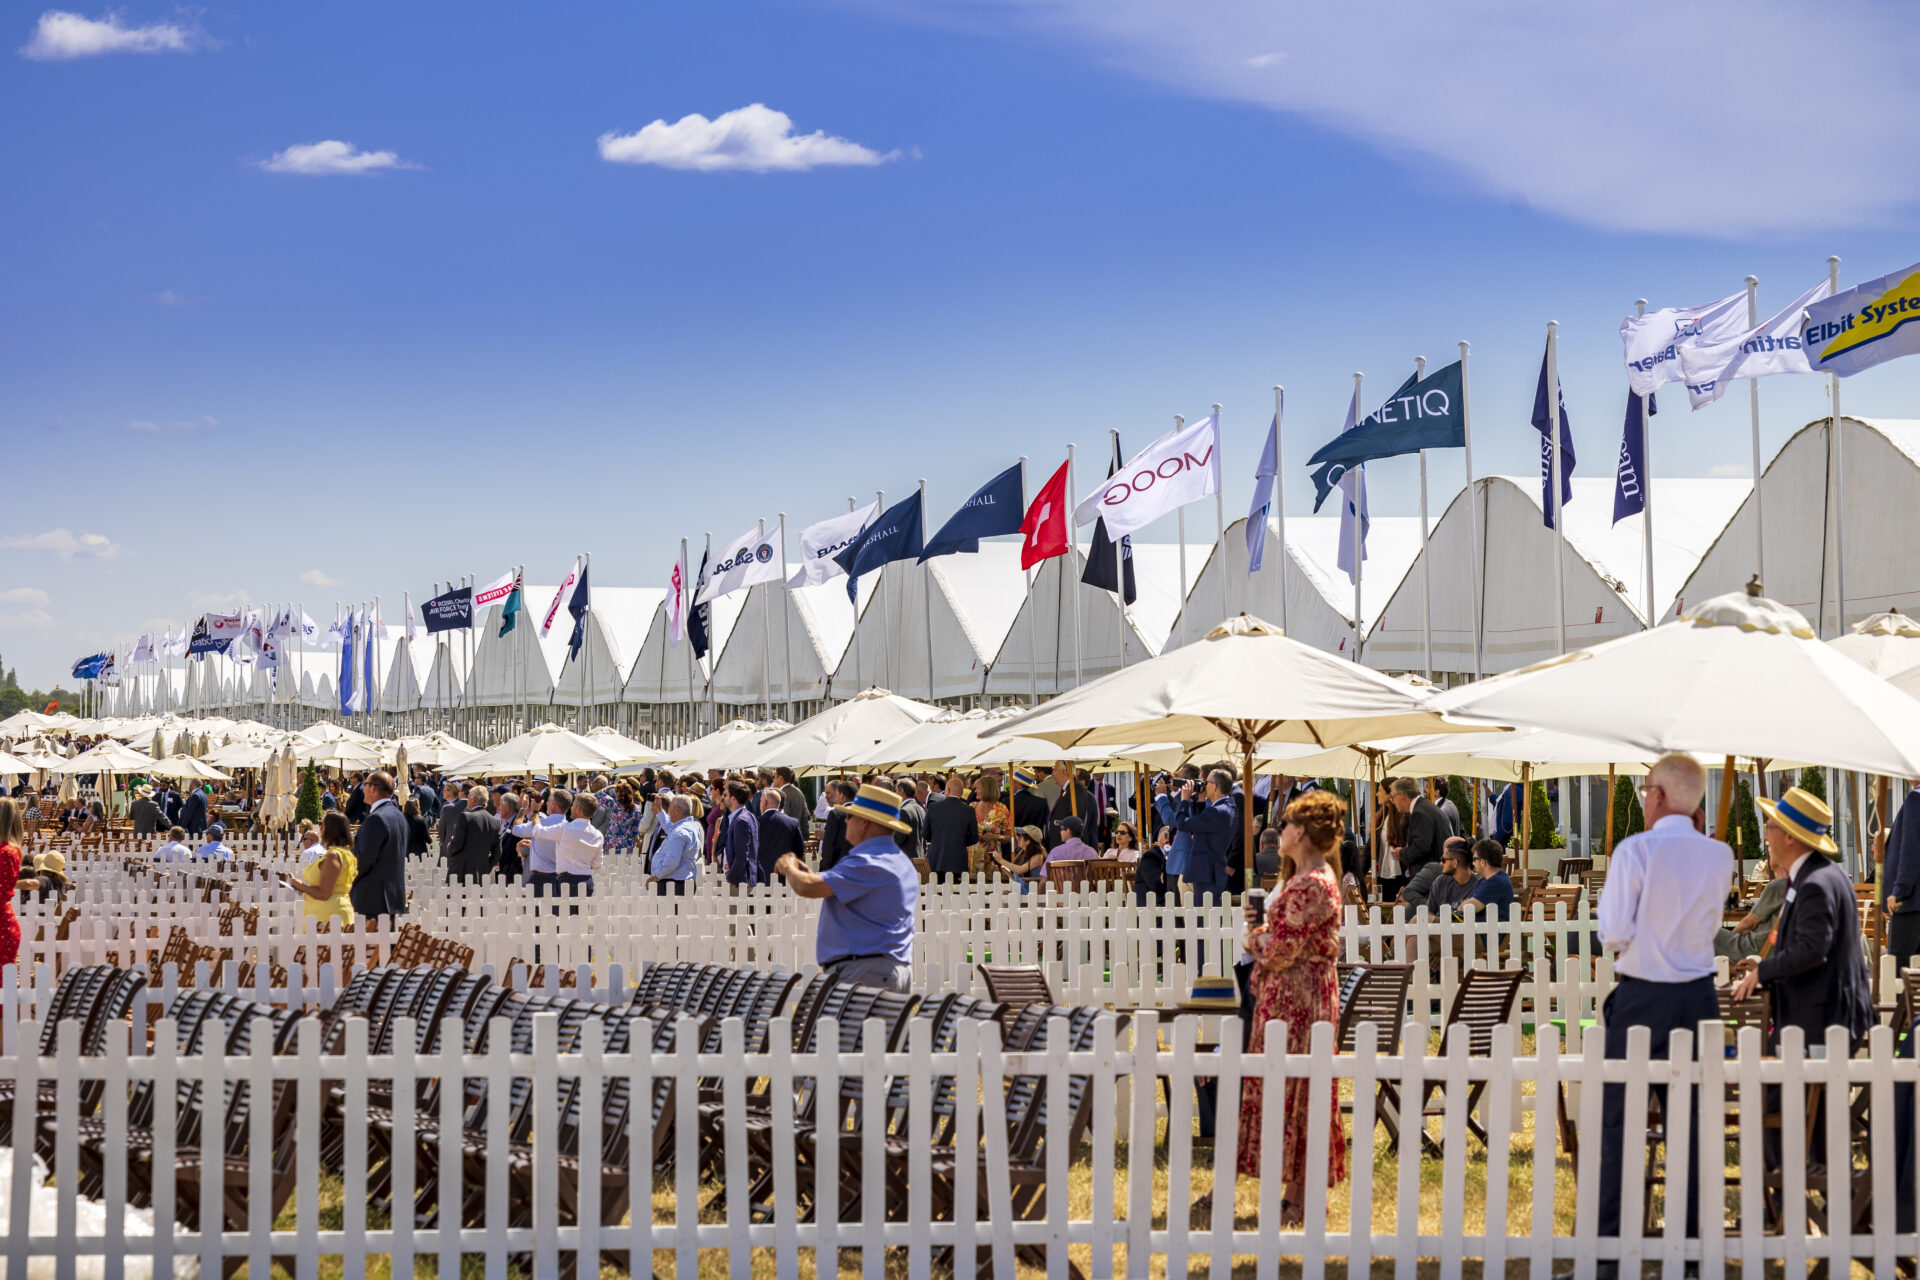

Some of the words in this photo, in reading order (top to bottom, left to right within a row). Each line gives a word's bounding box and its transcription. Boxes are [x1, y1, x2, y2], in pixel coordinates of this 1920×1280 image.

[1806, 313, 1855, 346] Elbit
[429, 607, 440, 615] AIR
[439, 604, 457, 612] FORCE
